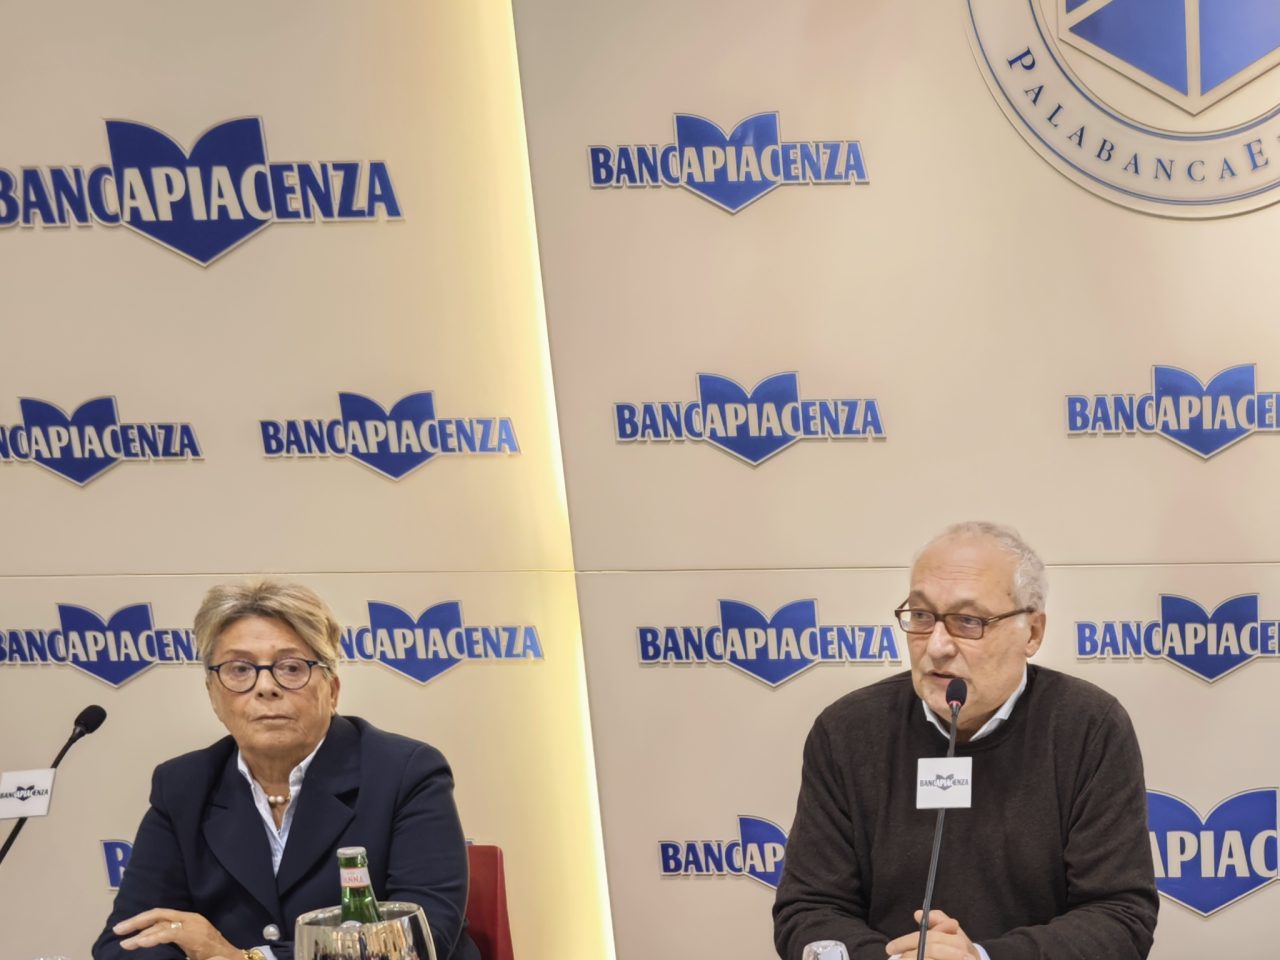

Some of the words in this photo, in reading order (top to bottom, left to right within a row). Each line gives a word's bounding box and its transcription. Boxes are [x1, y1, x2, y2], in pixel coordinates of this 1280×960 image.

[589, 141, 868, 186] BANCAPIACENZA
[258, 418, 520, 456] BANCAPIACENZA
[614, 399, 885, 440] BANCAPIACENZA
[0, 424, 203, 460] CAPIACENZA
[0, 629, 201, 662] ANCAPIACEN
[638, 626, 900, 662] BANCAPIACENZA
